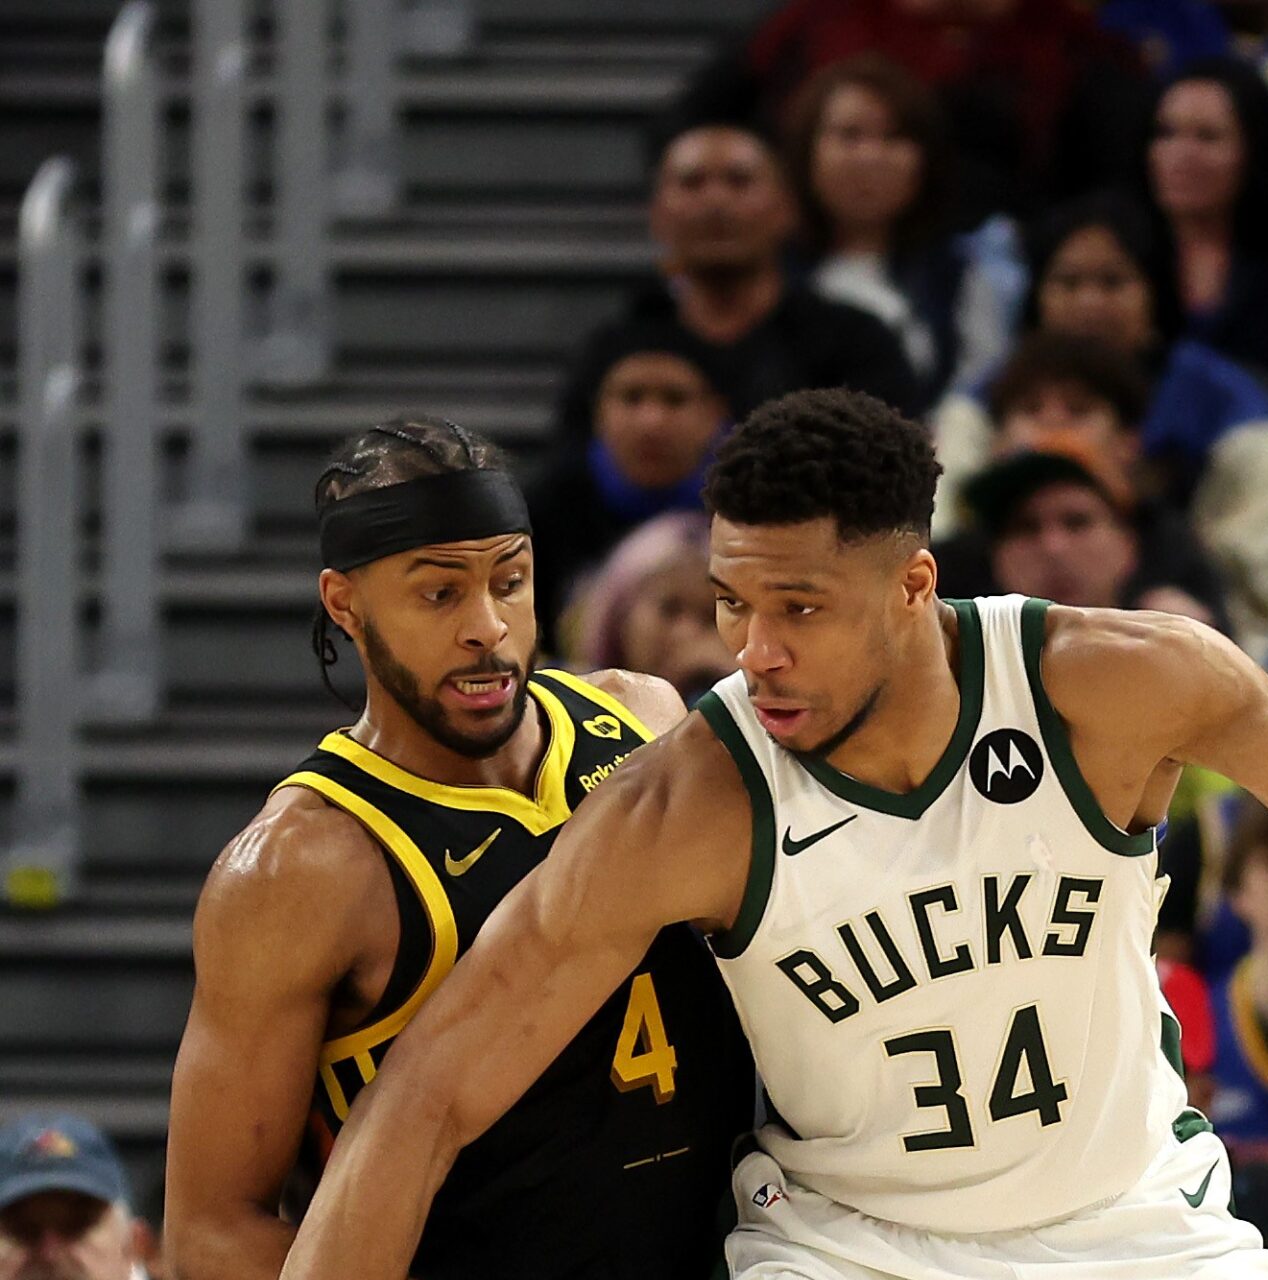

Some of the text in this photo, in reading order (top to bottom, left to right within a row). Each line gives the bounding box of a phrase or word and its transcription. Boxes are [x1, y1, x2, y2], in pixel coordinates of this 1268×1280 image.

[774, 872, 1104, 1024] BUCKS
[610, 972, 677, 1105] 4
[883, 1004, 1069, 1152] 34
